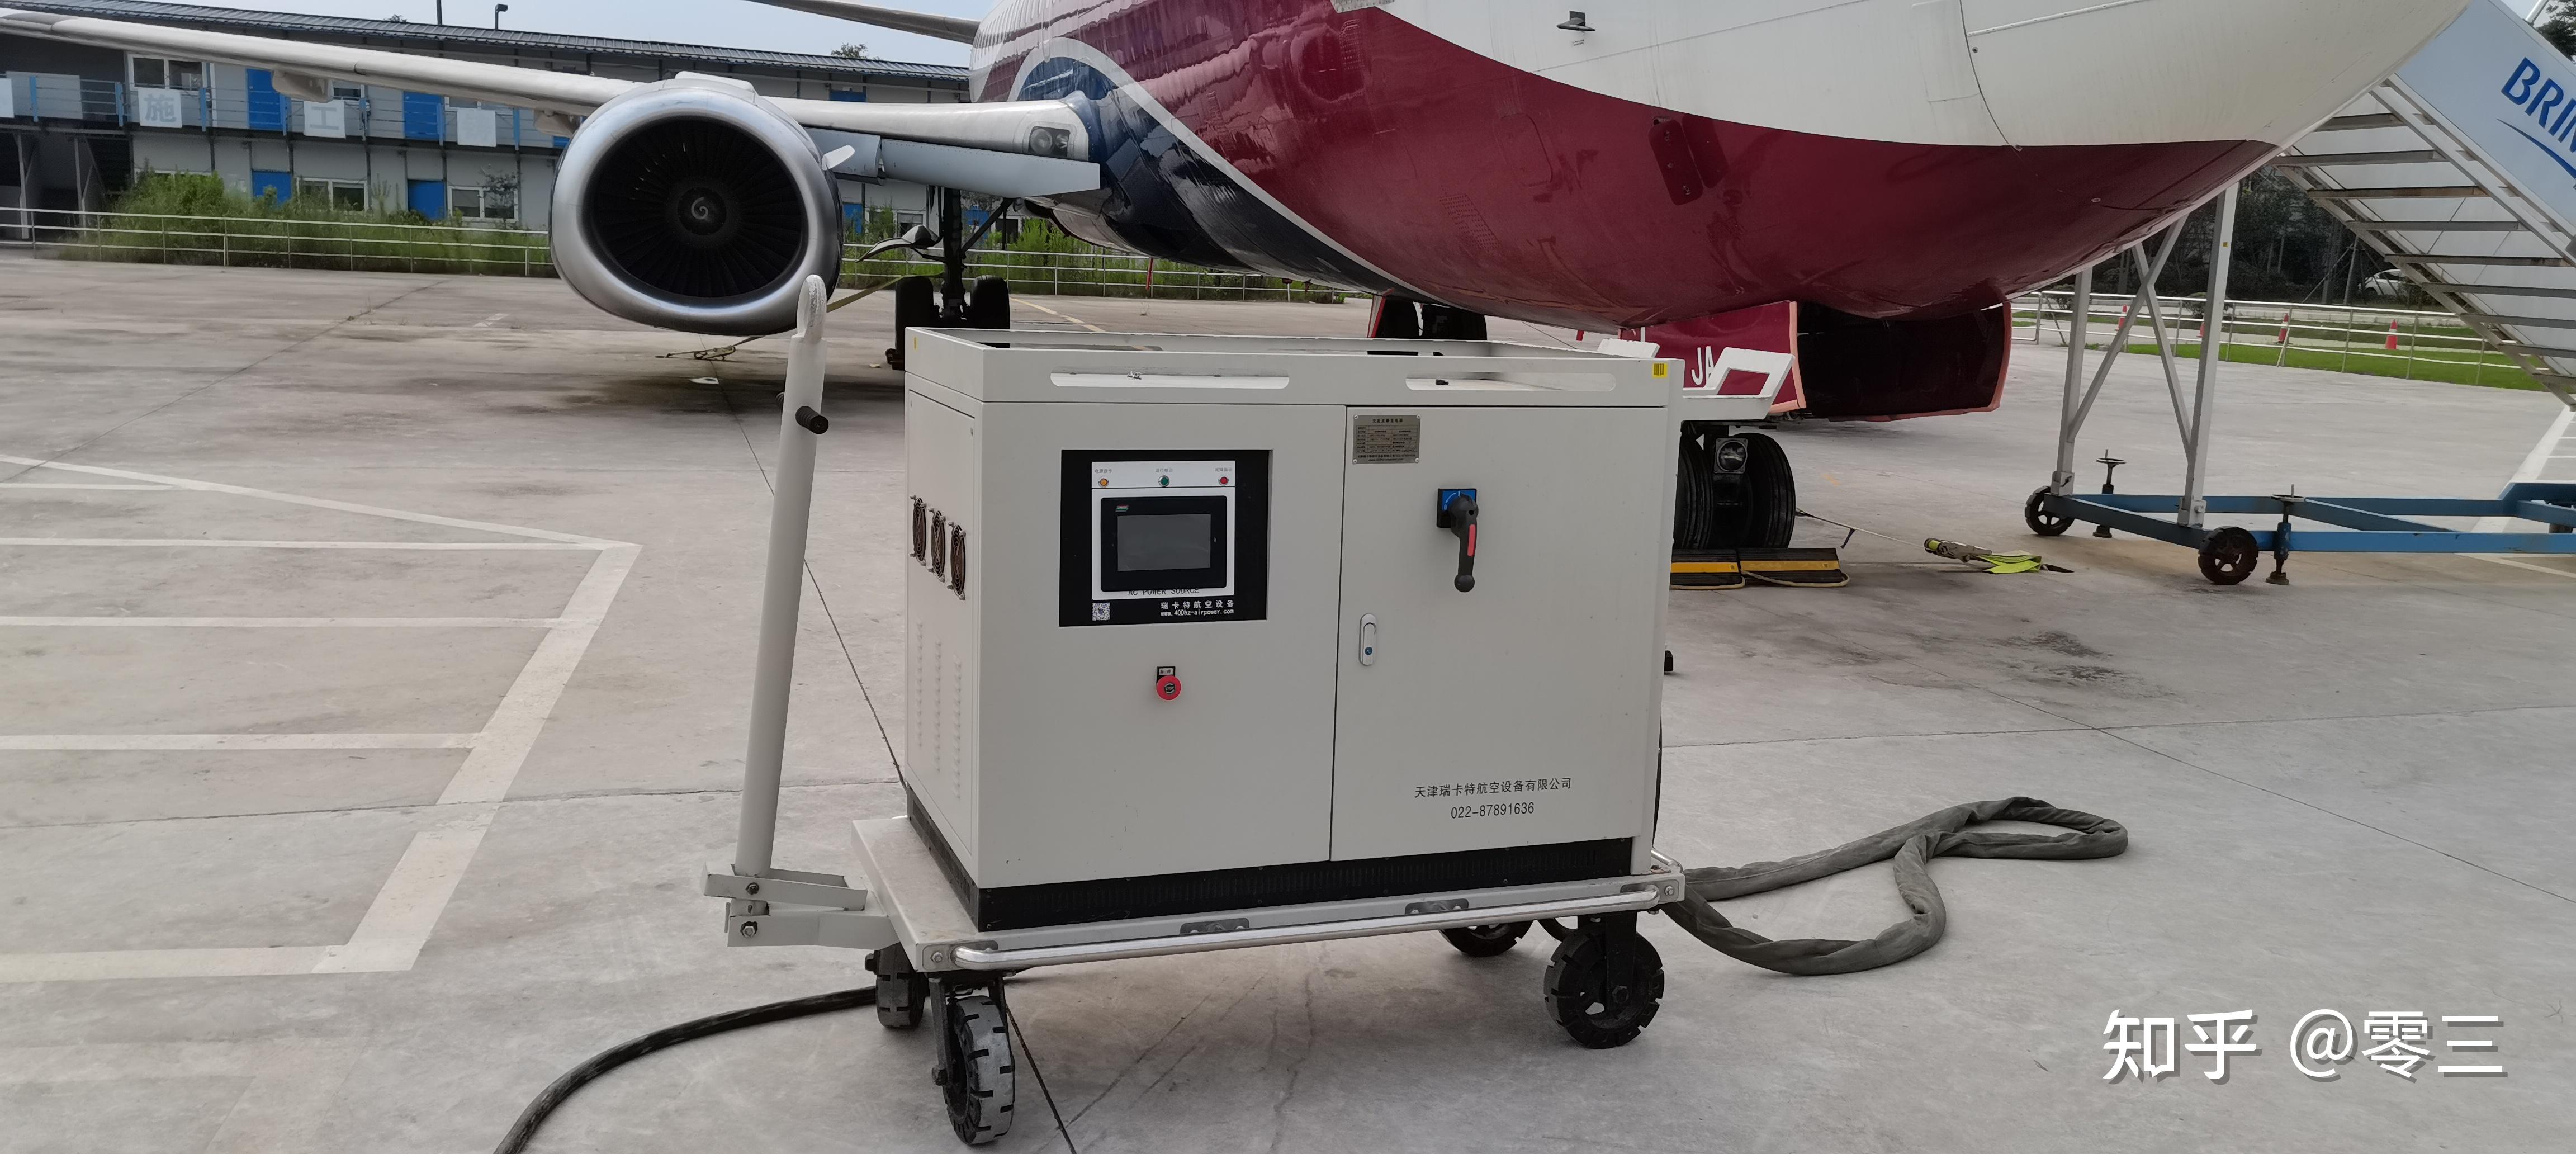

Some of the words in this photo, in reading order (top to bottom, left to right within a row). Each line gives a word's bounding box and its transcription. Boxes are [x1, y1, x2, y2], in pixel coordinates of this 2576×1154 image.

[144, 94, 177, 122] 施
[310, 106, 339, 130] 工
[1161, 600, 1234, 610] 瑞卡特航空设备
[1414, 777, 1571, 798] 天津瑞卡特航空设备有限公司
[1451, 802, 1534, 819] 022-87891636
